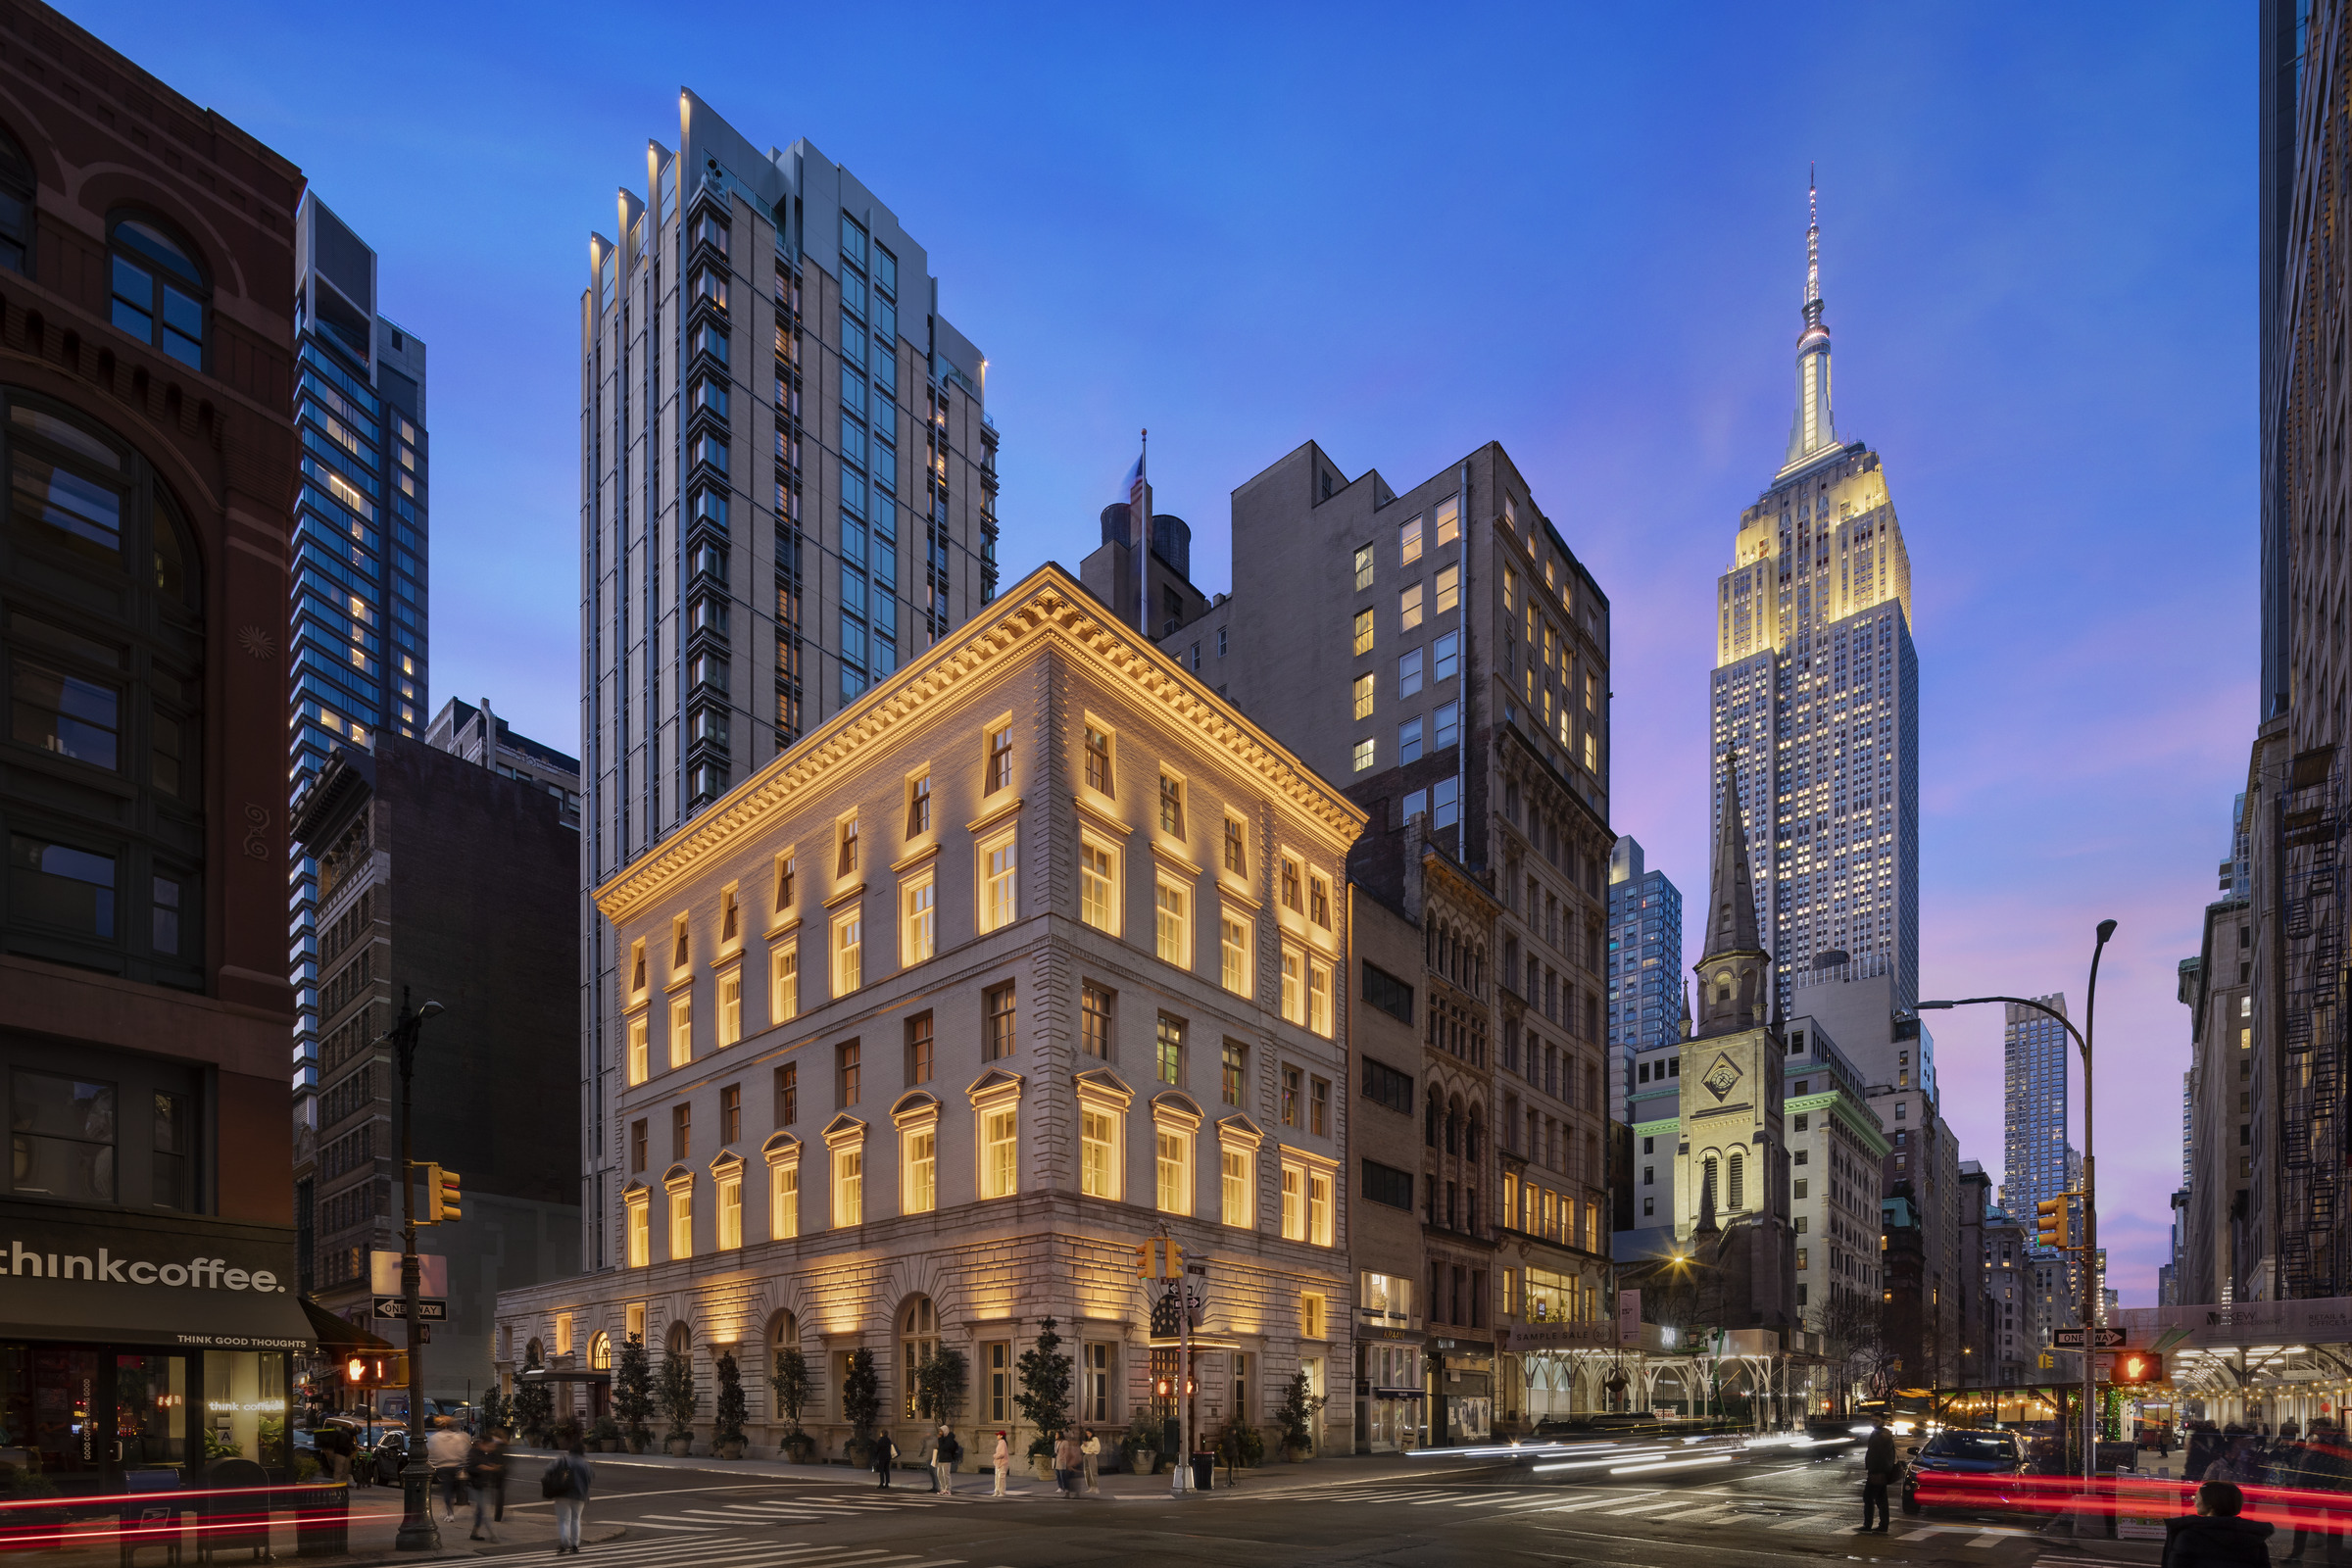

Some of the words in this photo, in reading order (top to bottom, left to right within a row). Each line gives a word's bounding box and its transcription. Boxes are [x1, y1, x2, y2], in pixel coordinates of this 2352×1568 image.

[385, 1304, 406, 1313] ONE
[2230, 1311, 2257, 1321] KEW
[177, 1335, 212, 1345] THINK
[215, 1336, 249, 1346] GOOD
[251, 1338, 307, 1348] THOUGHTS
[1516, 1333, 1557, 1342] SAMPLE
[1562, 1331, 1588, 1340] SALE
[209, 1401, 239, 1411] think
[220, 1432, 231, 1442] A
